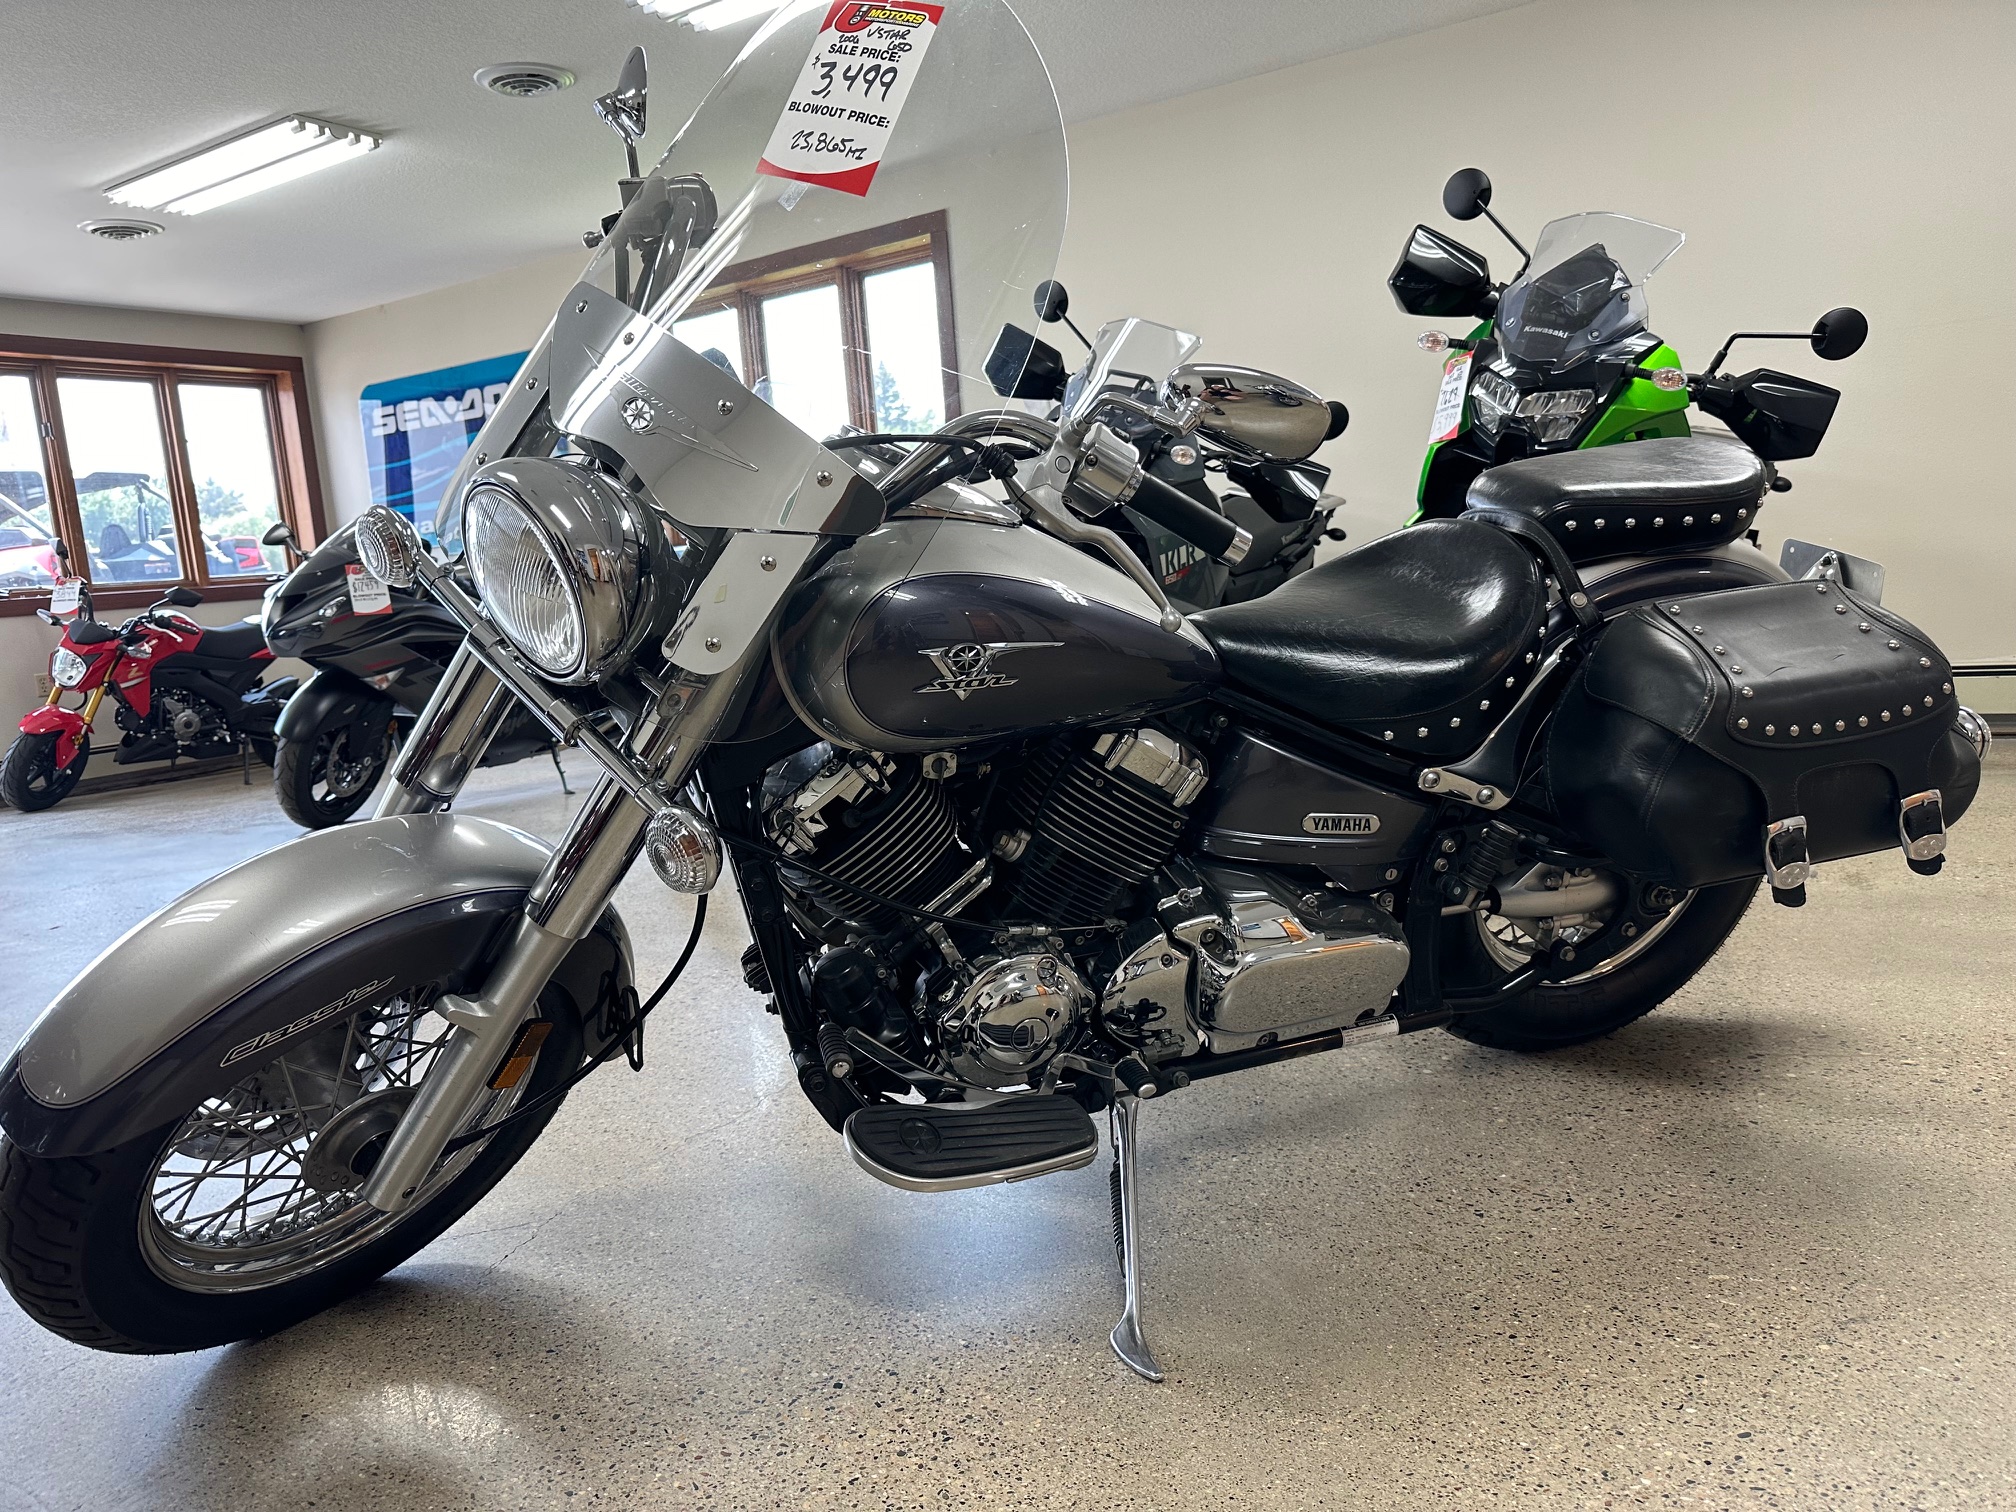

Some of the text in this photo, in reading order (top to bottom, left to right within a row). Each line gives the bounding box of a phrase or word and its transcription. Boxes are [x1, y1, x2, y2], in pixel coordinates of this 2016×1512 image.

[868, 9, 927, 24] MOTORS
[828, 43, 902, 63] SALE PRICE:
[788, 101, 890, 128] BLOWOUT PRICE:
[1523, 325, 1568, 339] Kawasaki
[1163, 543, 1200, 576] KLR
[1312, 817, 1371, 831] YAMAHA
